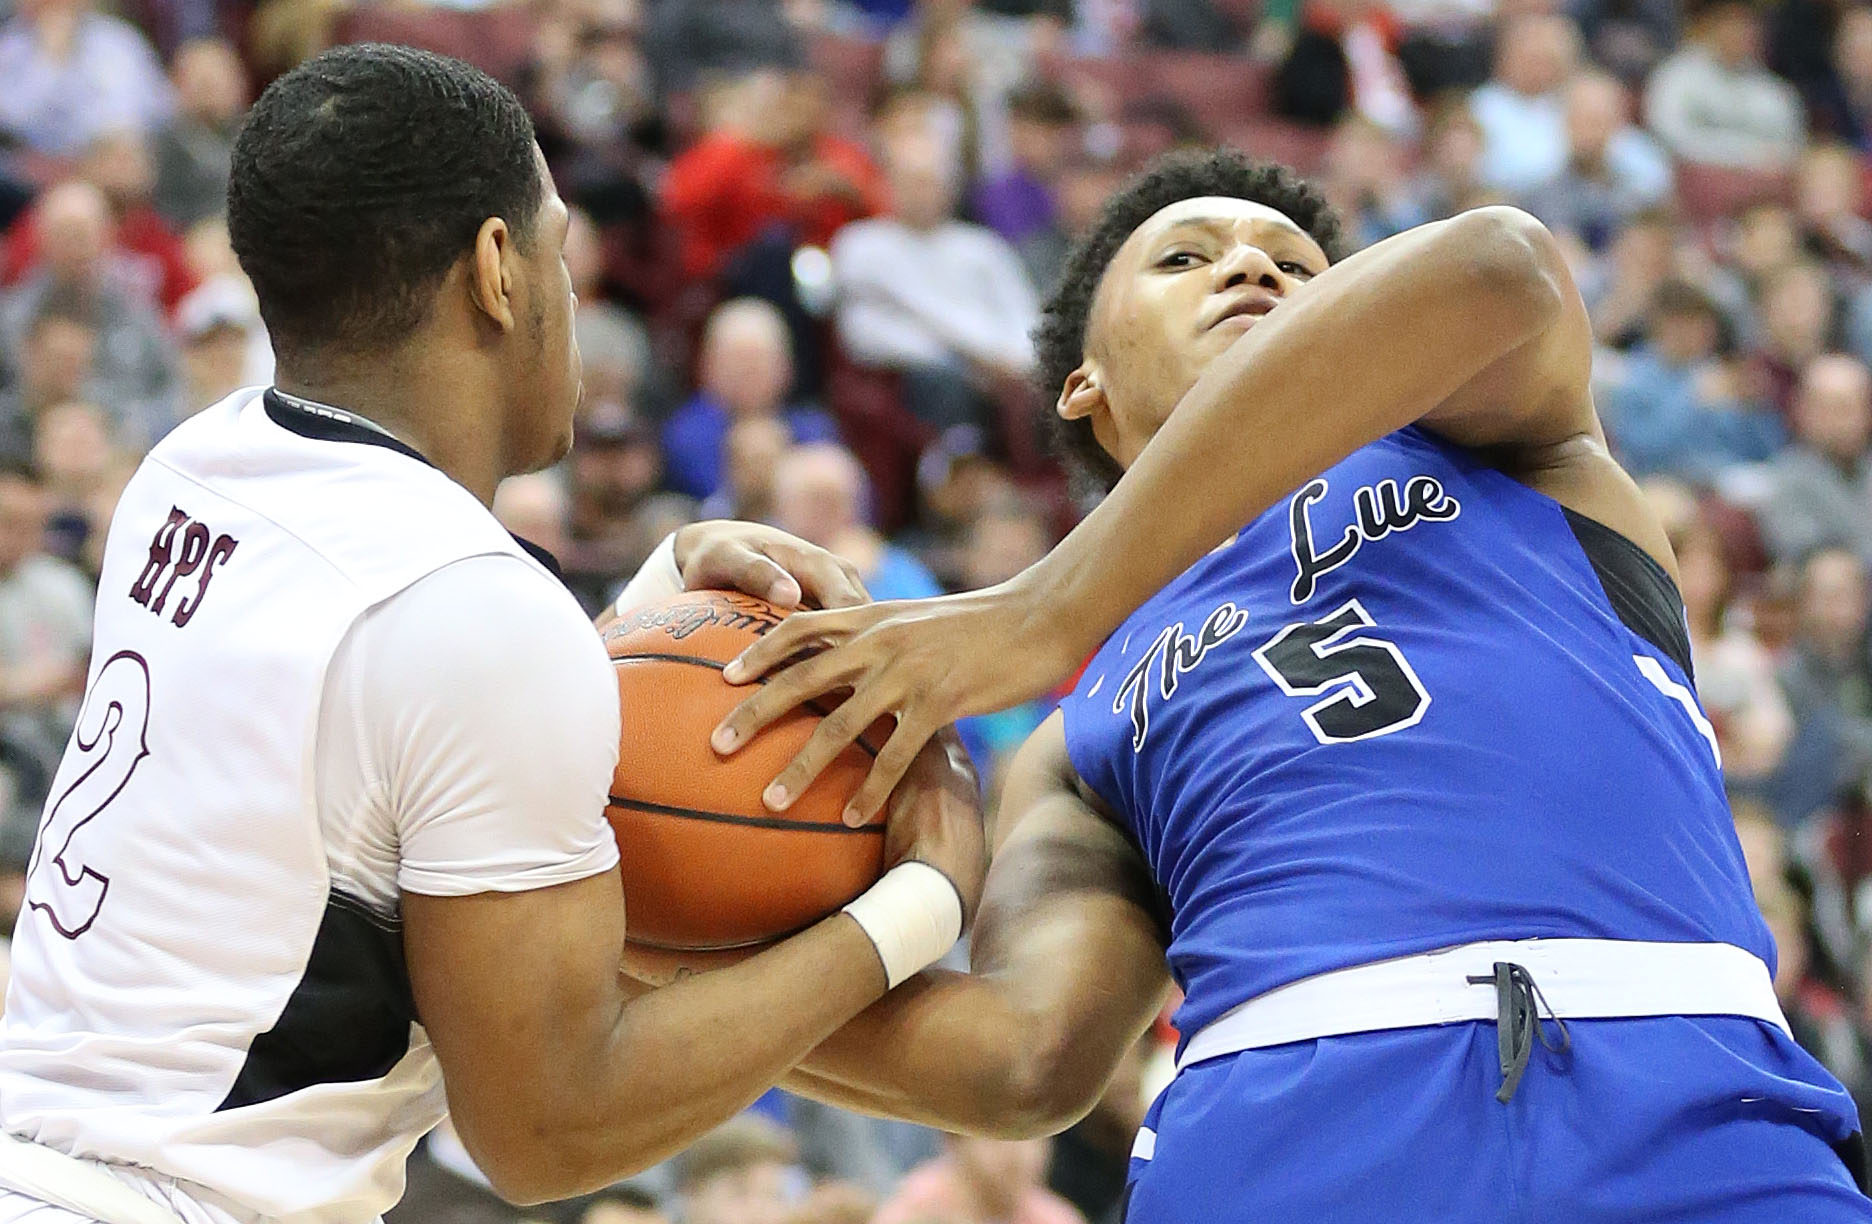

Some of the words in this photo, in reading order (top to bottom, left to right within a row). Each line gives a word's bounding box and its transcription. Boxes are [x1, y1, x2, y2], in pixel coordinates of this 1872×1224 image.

[129, 504, 239, 628] HPS
[1113, 602, 1249, 753] The
[1290, 475, 1461, 604] Lue
[1251, 598, 1432, 745] 5
[27, 650, 151, 940] 2
